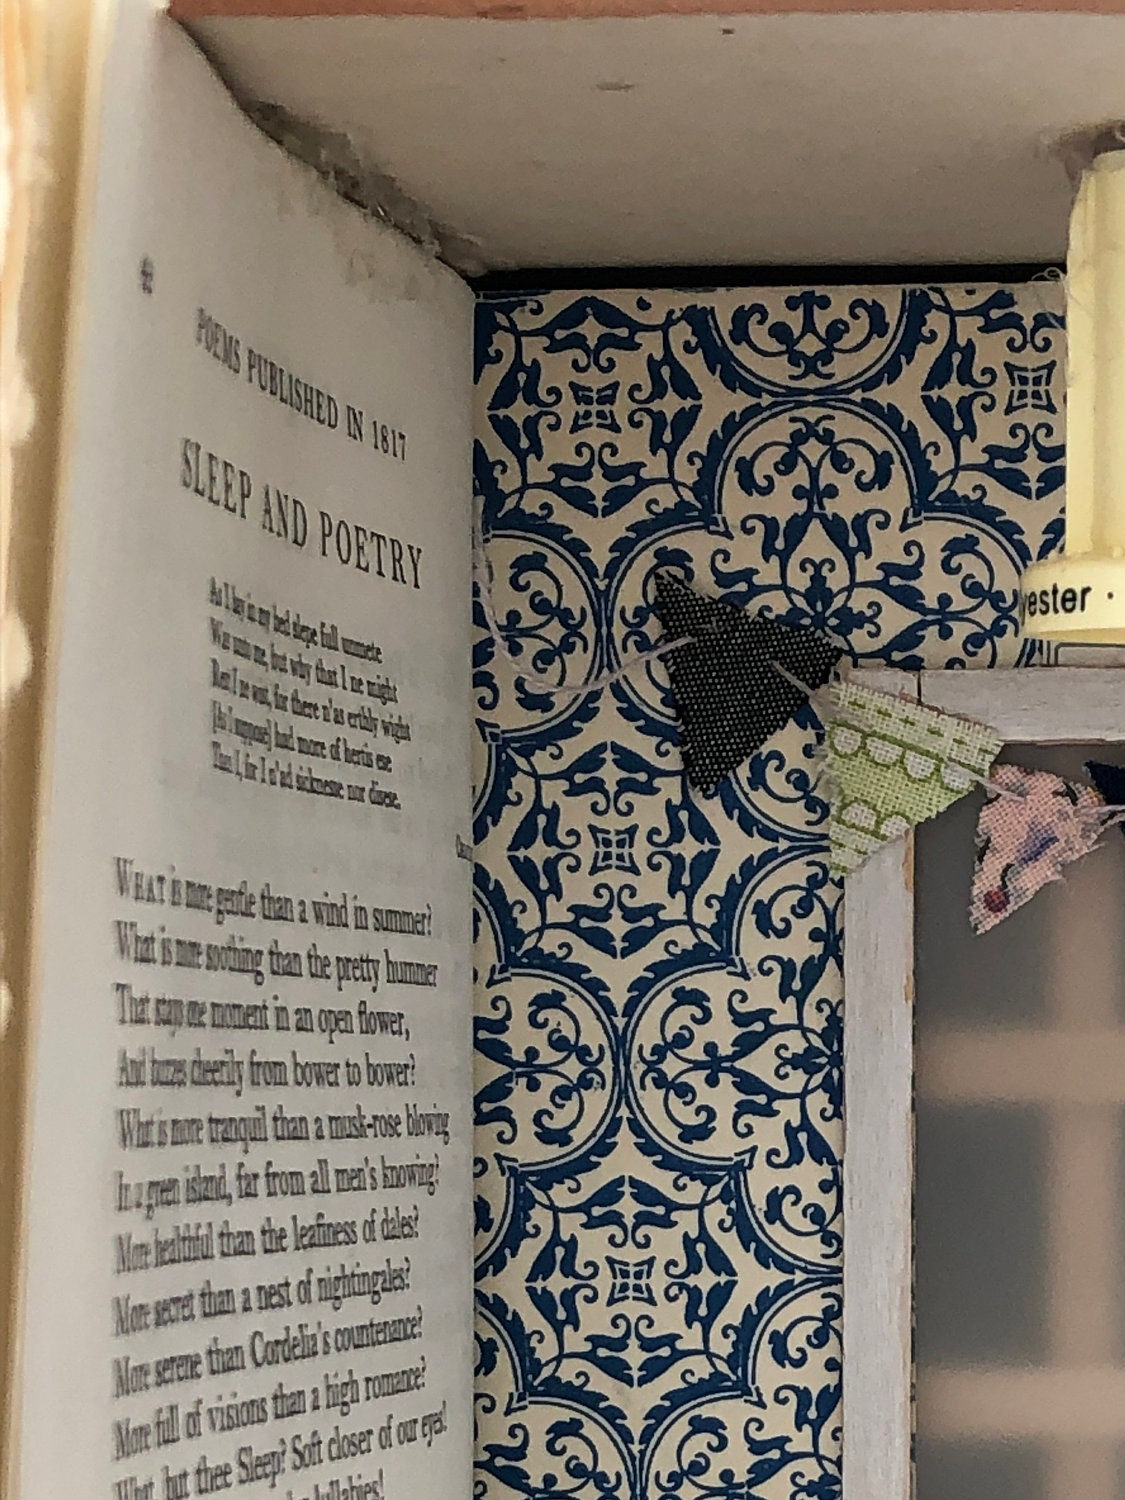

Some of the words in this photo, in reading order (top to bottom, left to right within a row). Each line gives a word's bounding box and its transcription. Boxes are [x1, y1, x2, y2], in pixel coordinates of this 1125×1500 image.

[199, 308, 241, 376] POEMS
[247, 347, 338, 430] PUBLISHED
[346, 404, 363, 443] IN
[373, 418, 408, 461] 1817
[180, 437, 253, 519] SLEEP
[261, 484, 308, 549] AND
[320, 510, 423, 589] POETRY
[261, 883, 294, 922] than
[312, 891, 348, 928] wind
[354, 895, 368, 929] in
[268, 941, 302, 977] than
[308, 944, 330, 981] the
[336, 954, 380, 992] pretty
[295, 1007, 314, 1033] an
[318, 1008, 354, 1044] open
[359, 1000, 410, 1041] flower,
[249, 1050, 288, 1087] from
[292, 1051, 340, 1087] bower
[345, 1062, 361, 1085] to
[315, 1113, 324, 1139] a
[329, 1104, 402, 1139] musk-rose
[406, 1103, 450, 1145] blowing
[237, 1162, 259, 1199] far
[266, 1161, 305, 1196] from
[335, 1162, 377, 1192] men's
[261, 1217, 286, 1254] the
[362, 1208, 376, 1242] of
[200, 1280, 236, 1318] than
[256, 1280, 291, 1310] nest
[297, 1267, 313, 1304] of
[206, 1337, 245, 1374] than
[250, 1322, 330, 1368] Cordelia's
[207, 1393, 268, 1432] visions
[272, 1382, 306, 1419] than
[325, 1369, 359, 1416] high
[291, 1425, 323, 1471] Soft
[328, 1426, 374, 1462] closer
